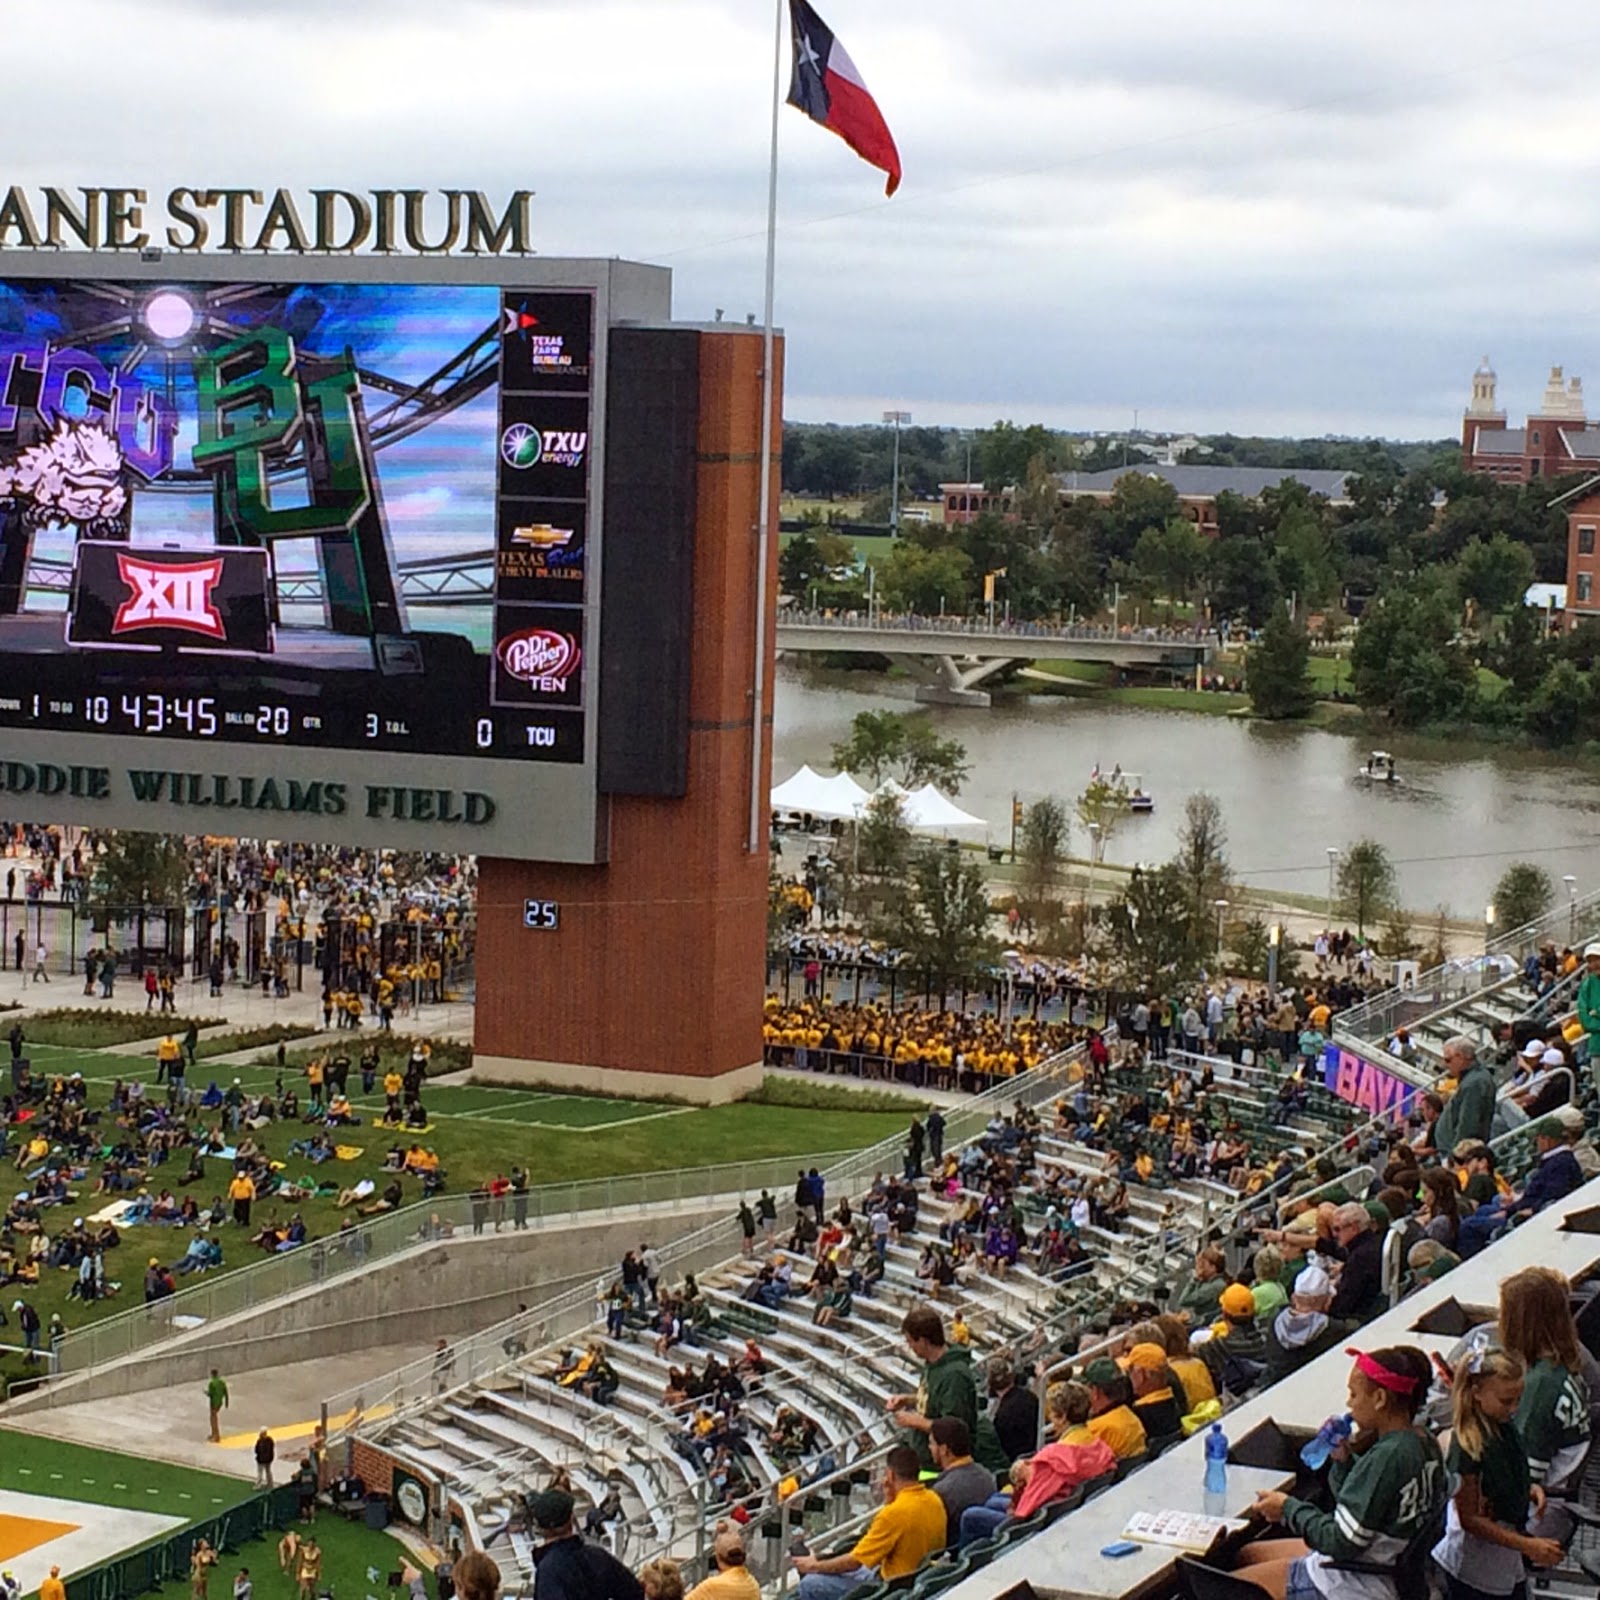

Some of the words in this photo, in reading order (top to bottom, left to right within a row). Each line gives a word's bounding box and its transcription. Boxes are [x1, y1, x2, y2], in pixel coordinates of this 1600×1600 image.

[166, 186, 536, 253] STADIUM
[532, 336, 563, 346] TEXAS
[542, 432, 587, 452] TXU
[541, 451, 584, 468] energy
[500, 551, 545, 567] TEXAS
[506, 640, 565, 673] Pepper
[528, 635, 551, 655] Dr
[528, 675, 567, 693] TEN
[85, 696, 109, 724] 10
[122, 694, 217, 735] 43:45
[256, 705, 290, 735] 20
[366, 713, 379, 738] 3
[526, 726, 555, 747] TCU
[0, 760, 111, 799] DDIE
[127, 768, 347, 815] WILLIAMS
[366, 784, 497, 826] FIELD
[526, 900, 556, 927] 25
